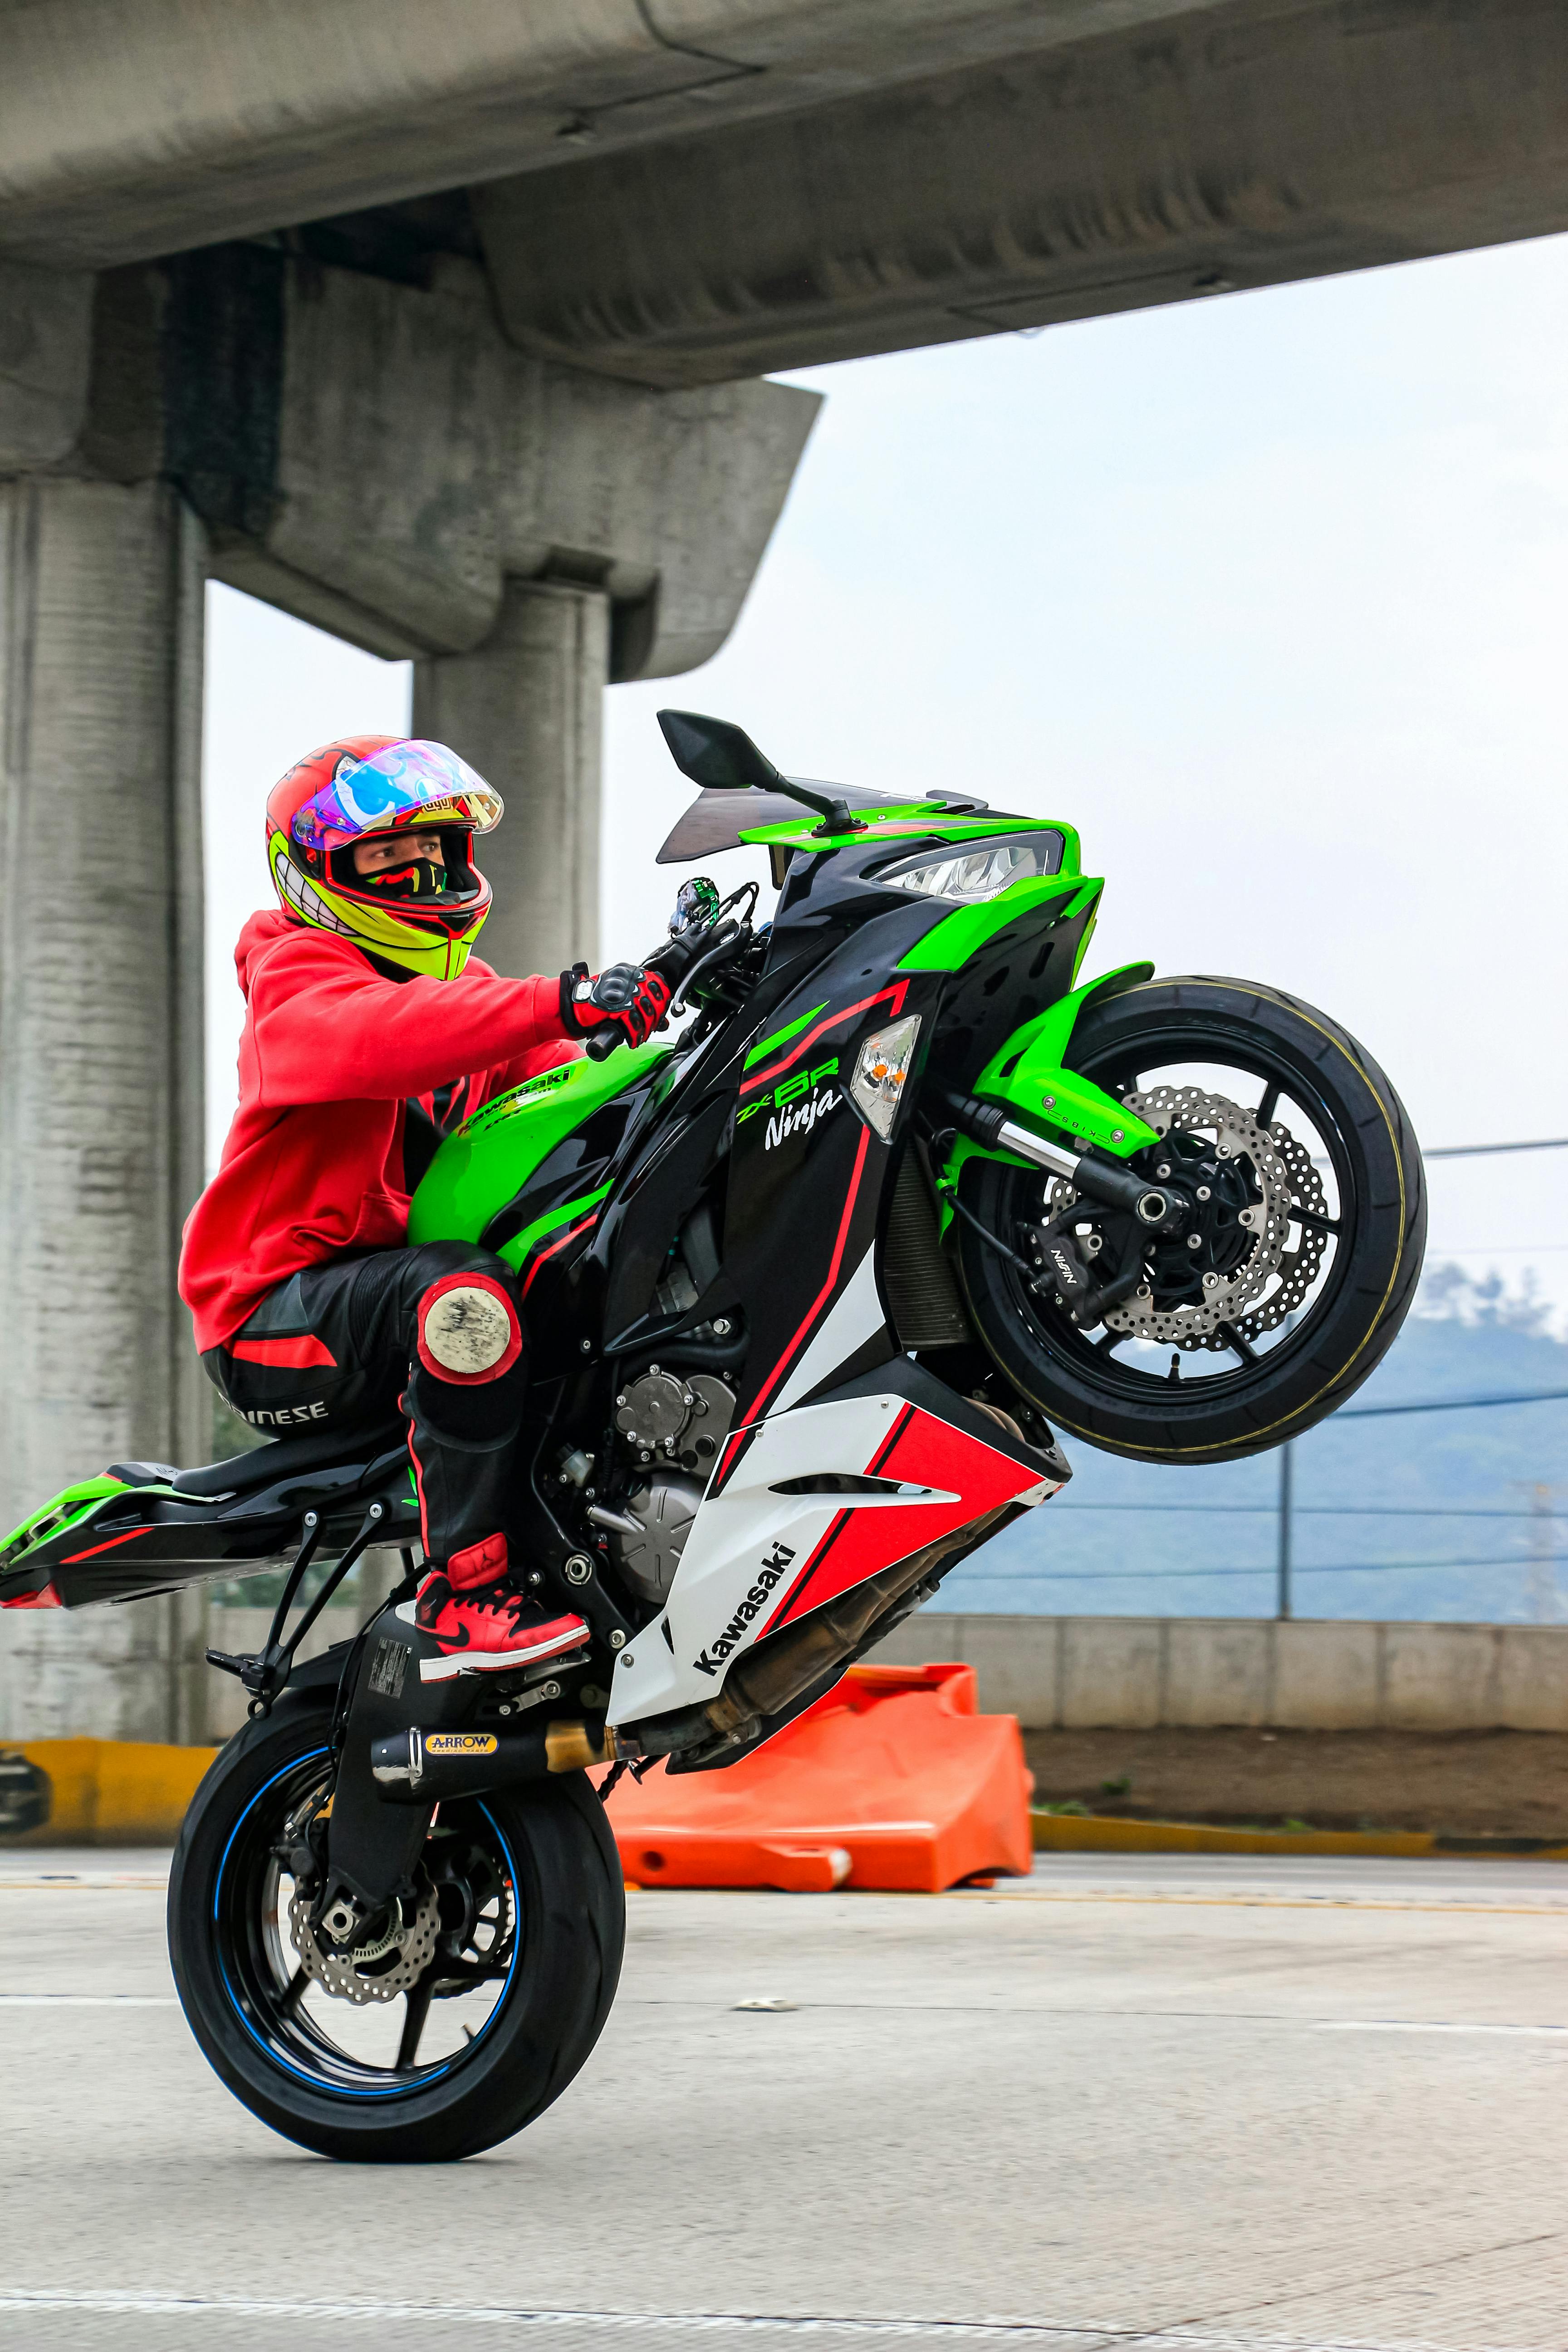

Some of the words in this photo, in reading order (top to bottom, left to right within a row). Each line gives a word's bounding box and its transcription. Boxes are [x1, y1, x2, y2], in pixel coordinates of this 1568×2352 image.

[457, 1069, 570, 1138] Kawasaki
[764, 1088, 843, 1150] Ninja
[1062, 1117, 1096, 1137] KIBS
[692, 1541, 797, 1677] Kawasaki
[431, 1736, 490, 1748] ARROW
